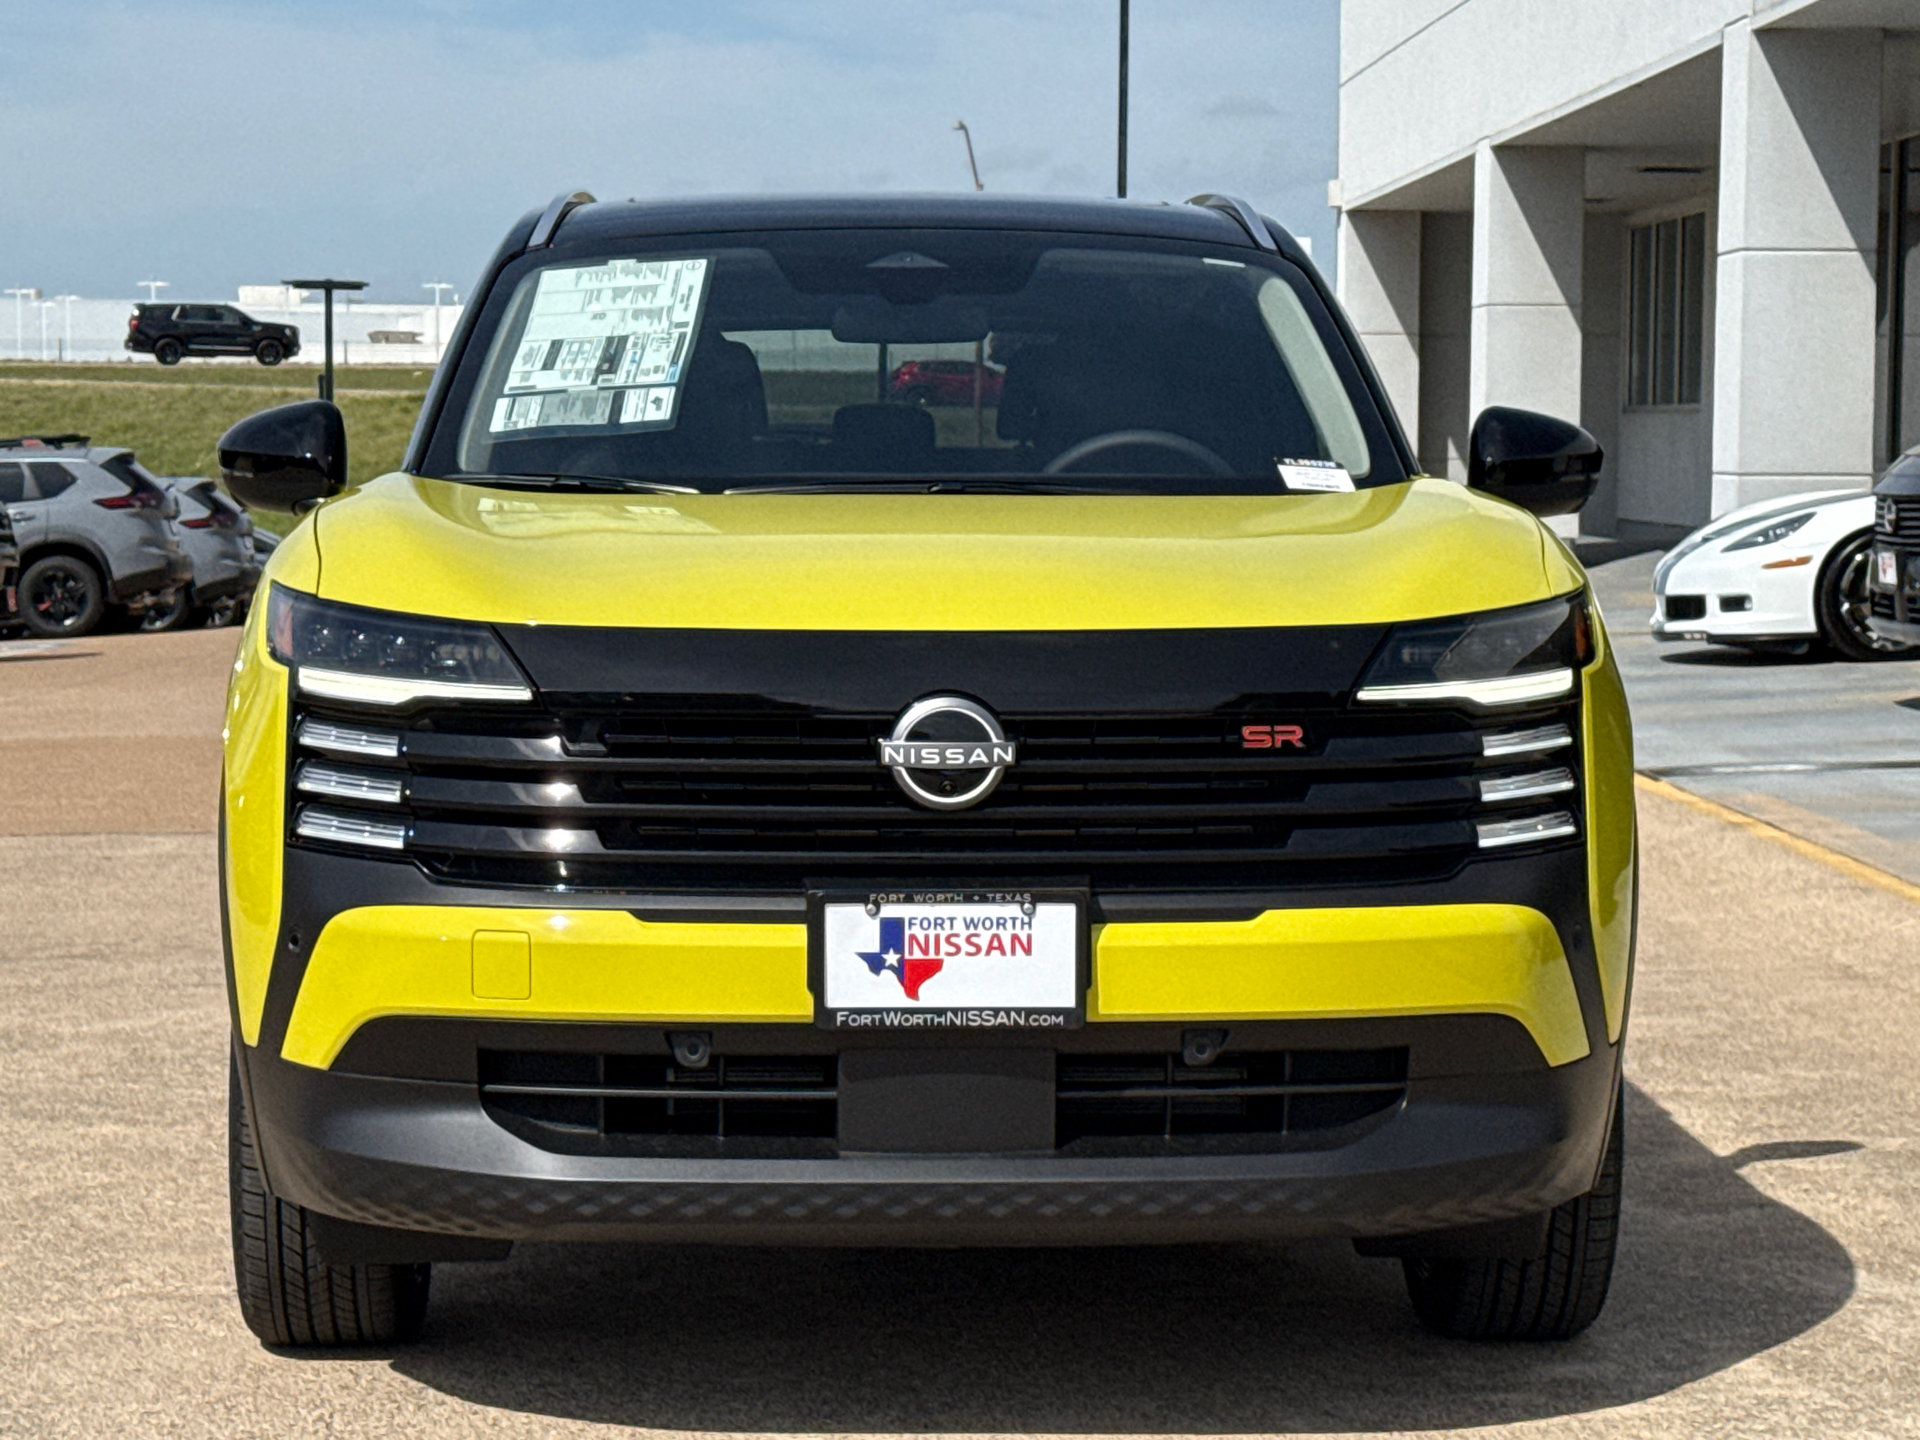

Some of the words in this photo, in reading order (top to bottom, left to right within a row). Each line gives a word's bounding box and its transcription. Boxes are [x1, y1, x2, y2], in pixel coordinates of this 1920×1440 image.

[1242, 725, 1304, 748] SR
[884, 746, 1013, 764] NISSAN
[869, 893, 905, 903] FORT
[913, 893, 964, 903] WORTH
[986, 893, 1032, 902] TEXAS
[908, 916, 957, 931] FORT
[963, 916, 1033, 931] WORTH
[908, 933, 1033, 957] NISSAN
